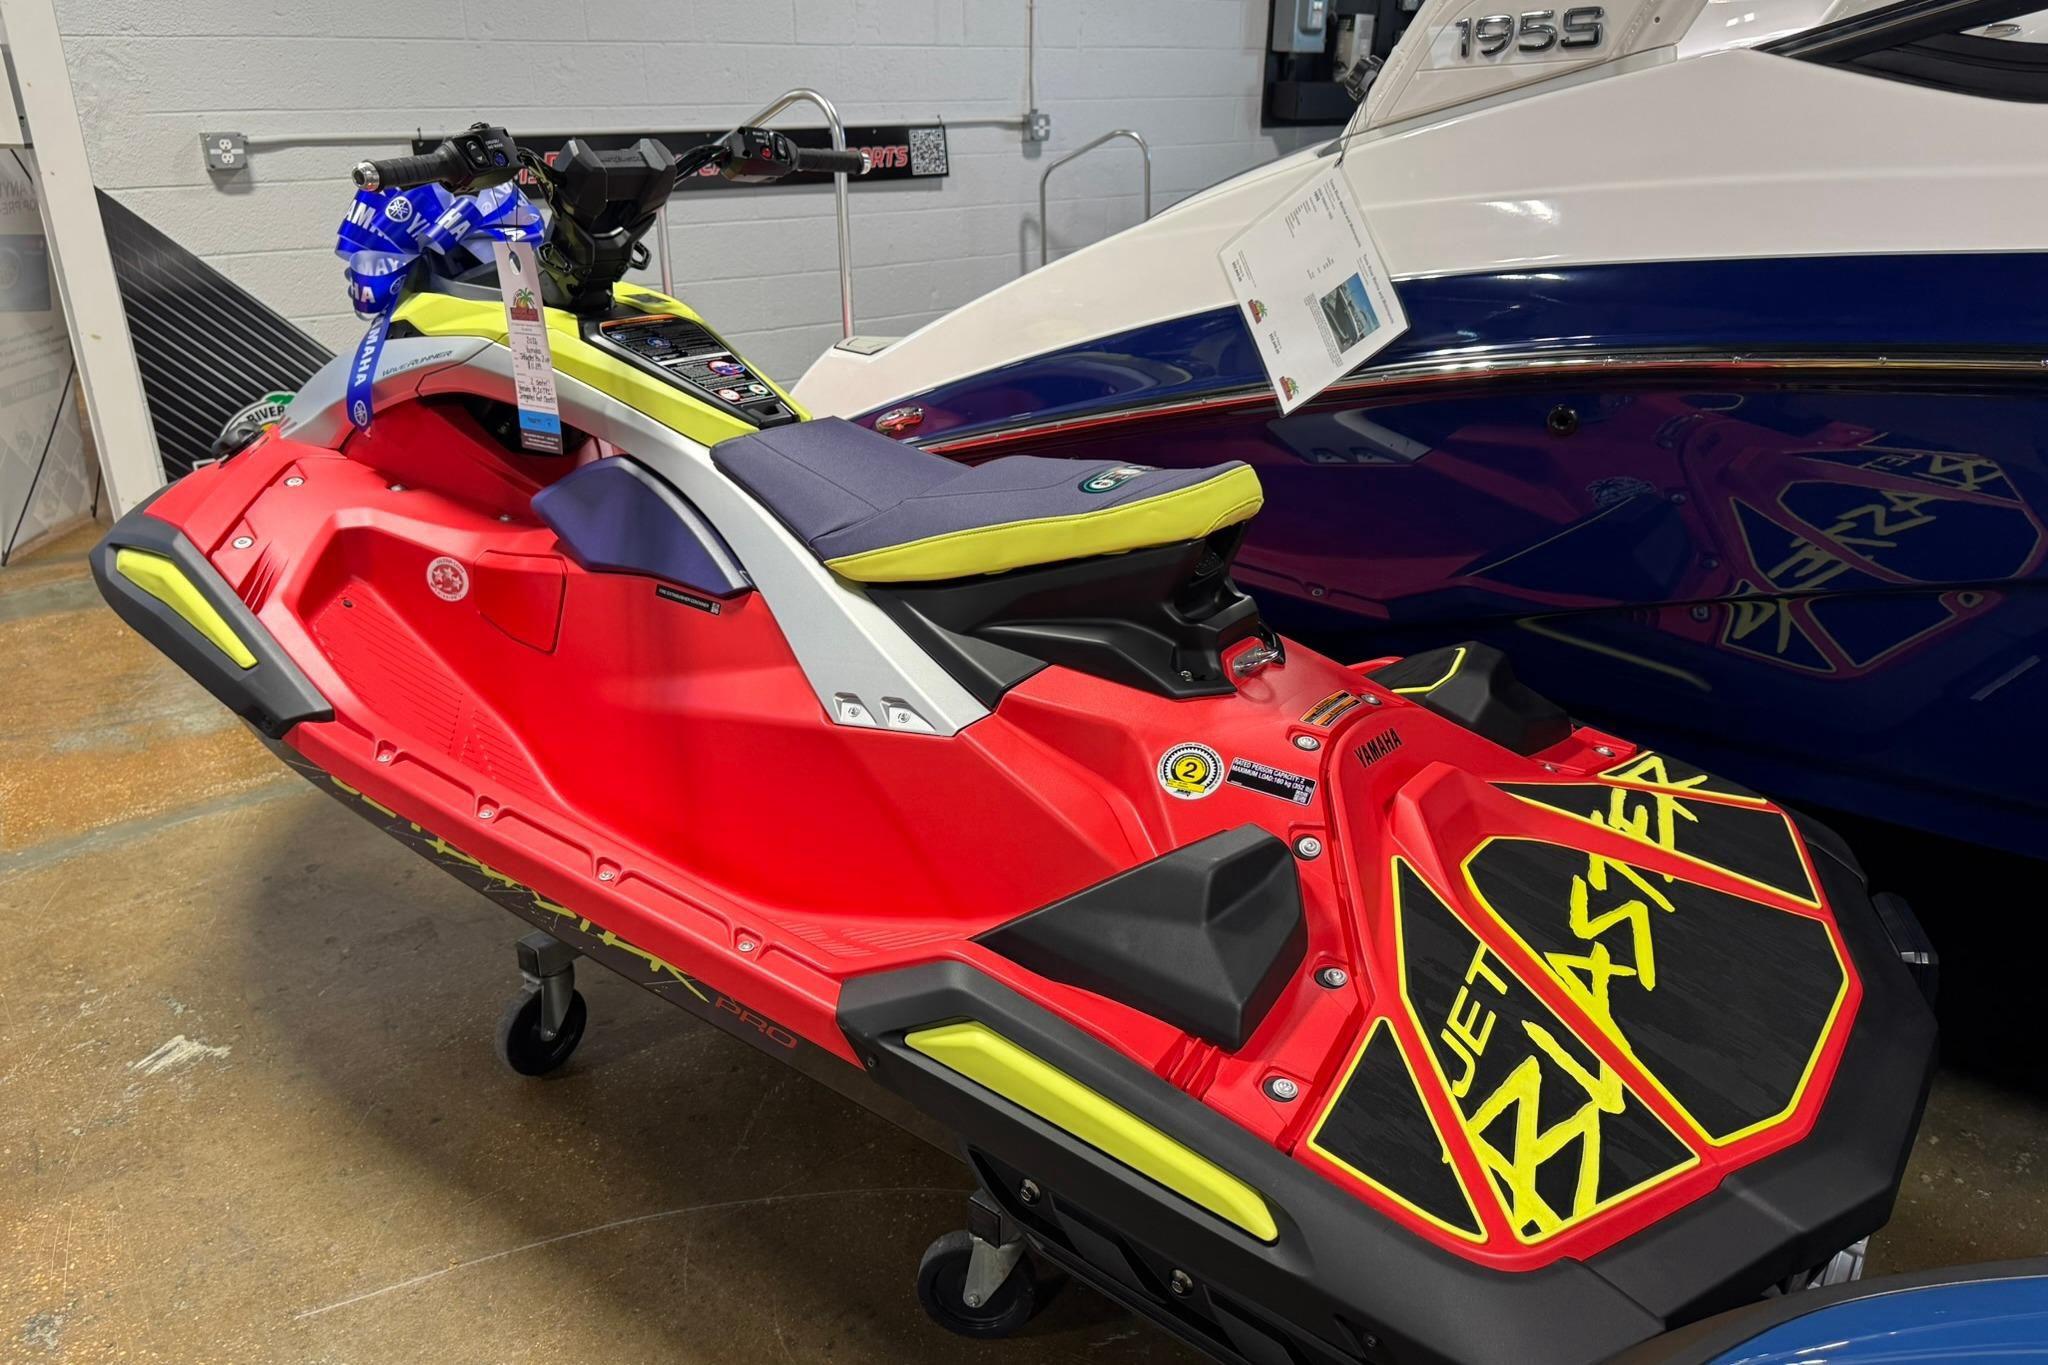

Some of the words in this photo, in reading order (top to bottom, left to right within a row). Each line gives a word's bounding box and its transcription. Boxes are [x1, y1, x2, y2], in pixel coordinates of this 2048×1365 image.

[1455, 6, 1605, 58] 195S
[1183, 761, 1198, 778] 2
[1233, 758, 1251, 768] RATED
[1251, 764, 1273, 774] PERSON
[1272, 770, 1300, 782] CAPACITY:
[1354, 727, 1403, 768] YAMAHA
[1231, 764, 1258, 777] MAXIMUM
[1283, 780, 1291, 788] kg
[1443, 753, 1712, 1236] BLASTER
[715, 996, 798, 1049] PRO
[1441, 941, 1508, 1098] JET
